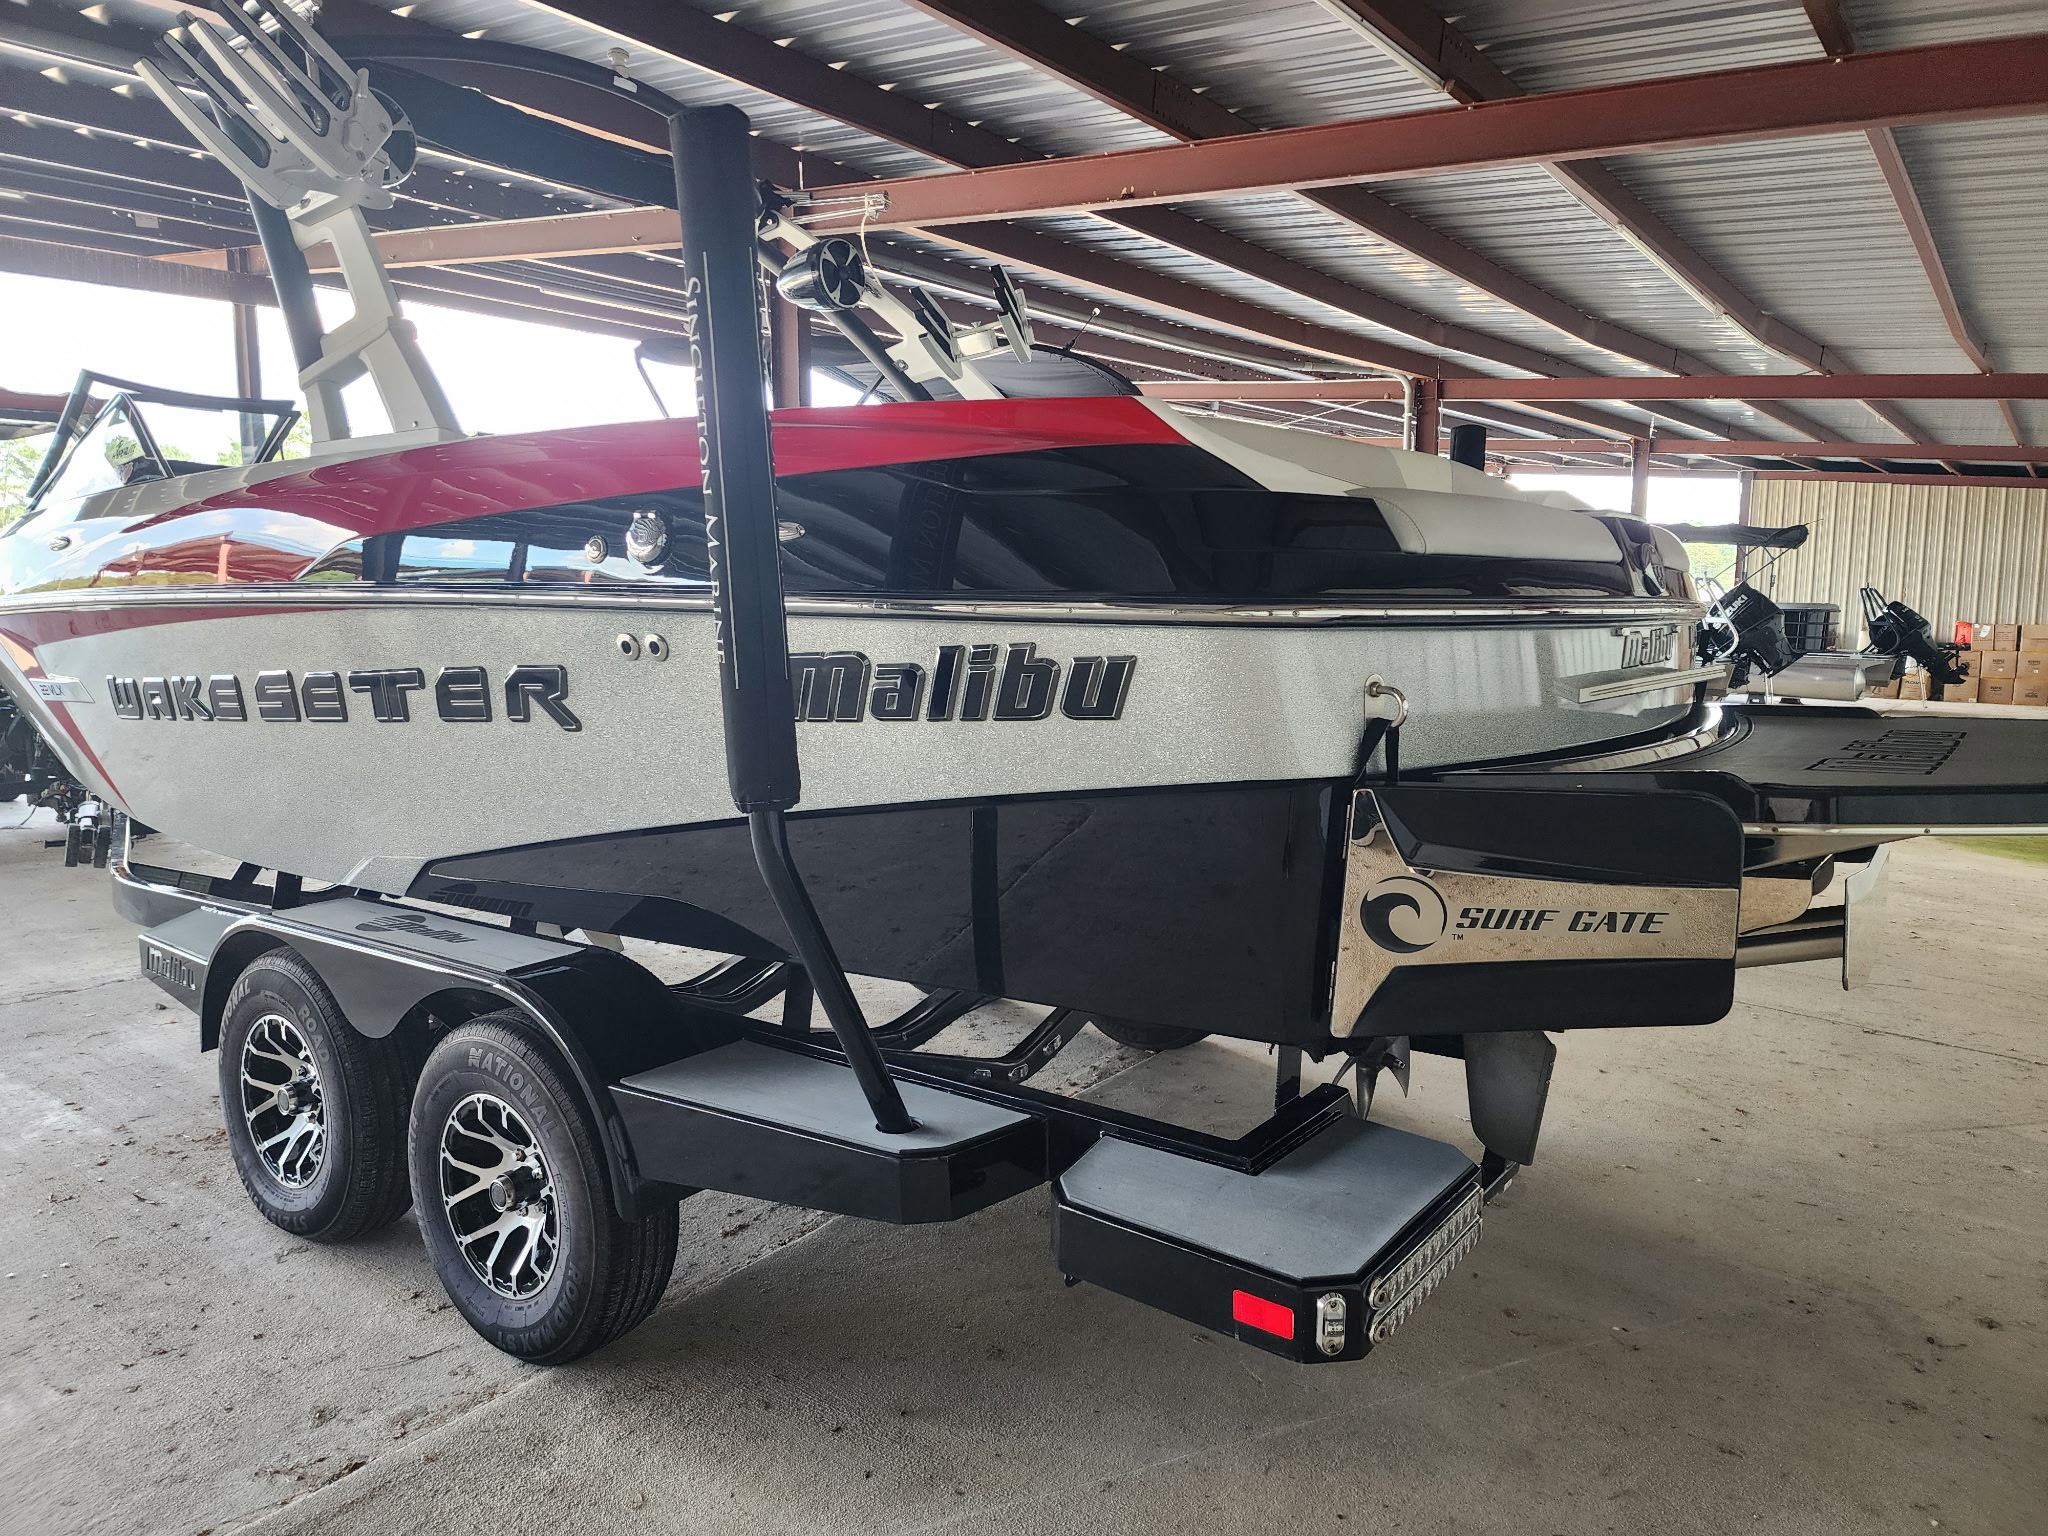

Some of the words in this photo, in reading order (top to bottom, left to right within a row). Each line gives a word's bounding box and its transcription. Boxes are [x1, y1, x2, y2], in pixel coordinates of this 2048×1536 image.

[1712, 594, 1748, 630] SZUKI
[1456, 907, 1560, 931] SURF
[1567, 911, 1670, 934] GATE
[298, 1003, 330, 1062] ROAD
[468, 1047, 557, 1139] NATIONAL
